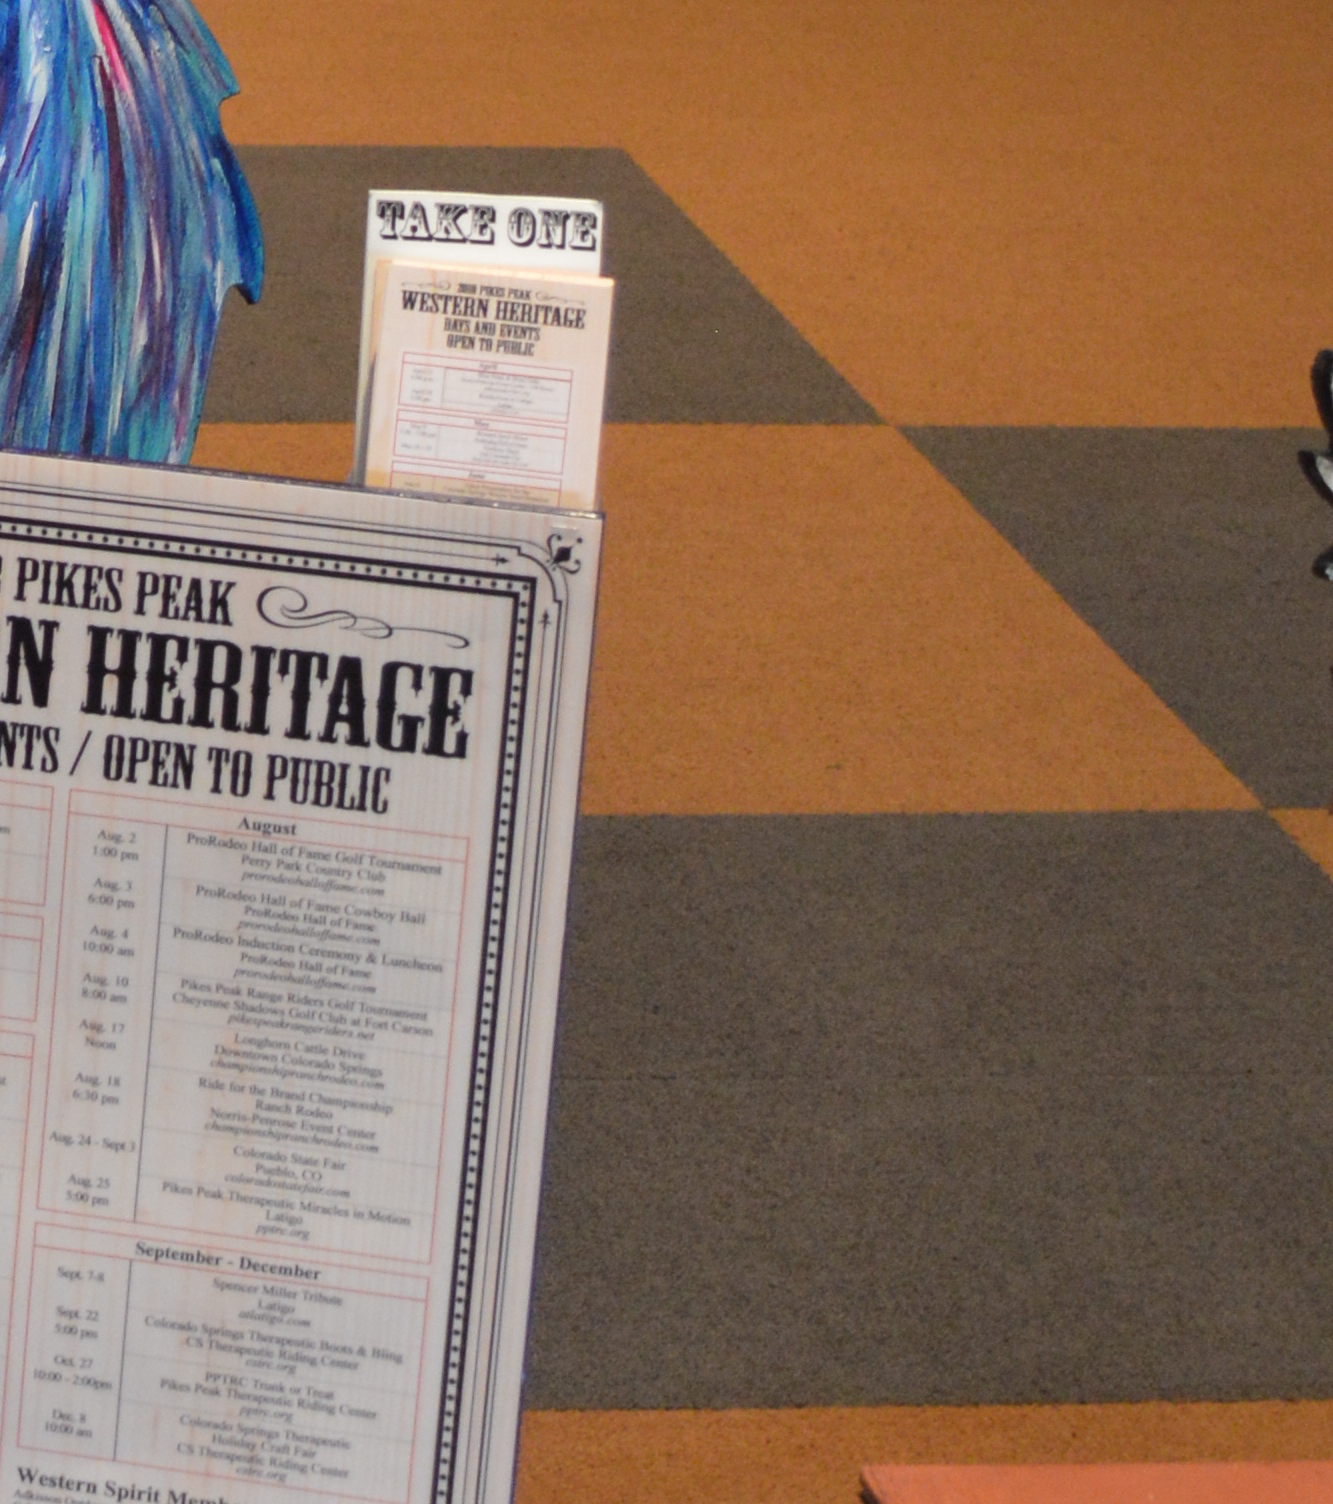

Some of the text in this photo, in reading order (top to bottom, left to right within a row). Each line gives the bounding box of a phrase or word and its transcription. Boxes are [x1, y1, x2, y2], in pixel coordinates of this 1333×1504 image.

[376, 199, 598, 252] TAKE ONE
[400, 289, 587, 330] WESTERN HERITAGE
[444, 317, 541, 341] DAYS AND EVENTS
[446, 333, 536, 357] OPEN TO PUBLIC
[12, 555, 124, 614] PIKES
[132, 570, 237, 627] PEAK
[79, 623, 475, 760] HERITAGE
[68, 729, 93, 776] /
[102, 733, 198, 791] OPEN
[206, 745, 254, 798] TO
[262, 753, 392, 815] PUBLIC
[96, 828, 125, 845] Aug.
[237, 815, 297, 837] August
[186, 831, 443, 876] ProRodeo Hall of Fame Golf Tournament
[240, 852, 387, 884] Perry Park Country Club
[135, 1240, 223, 1267] September
[238, 1255, 321, 1281] December
[15, 1466, 98, 1503] Western
[103, 1480, 160, 1504] Spirit
